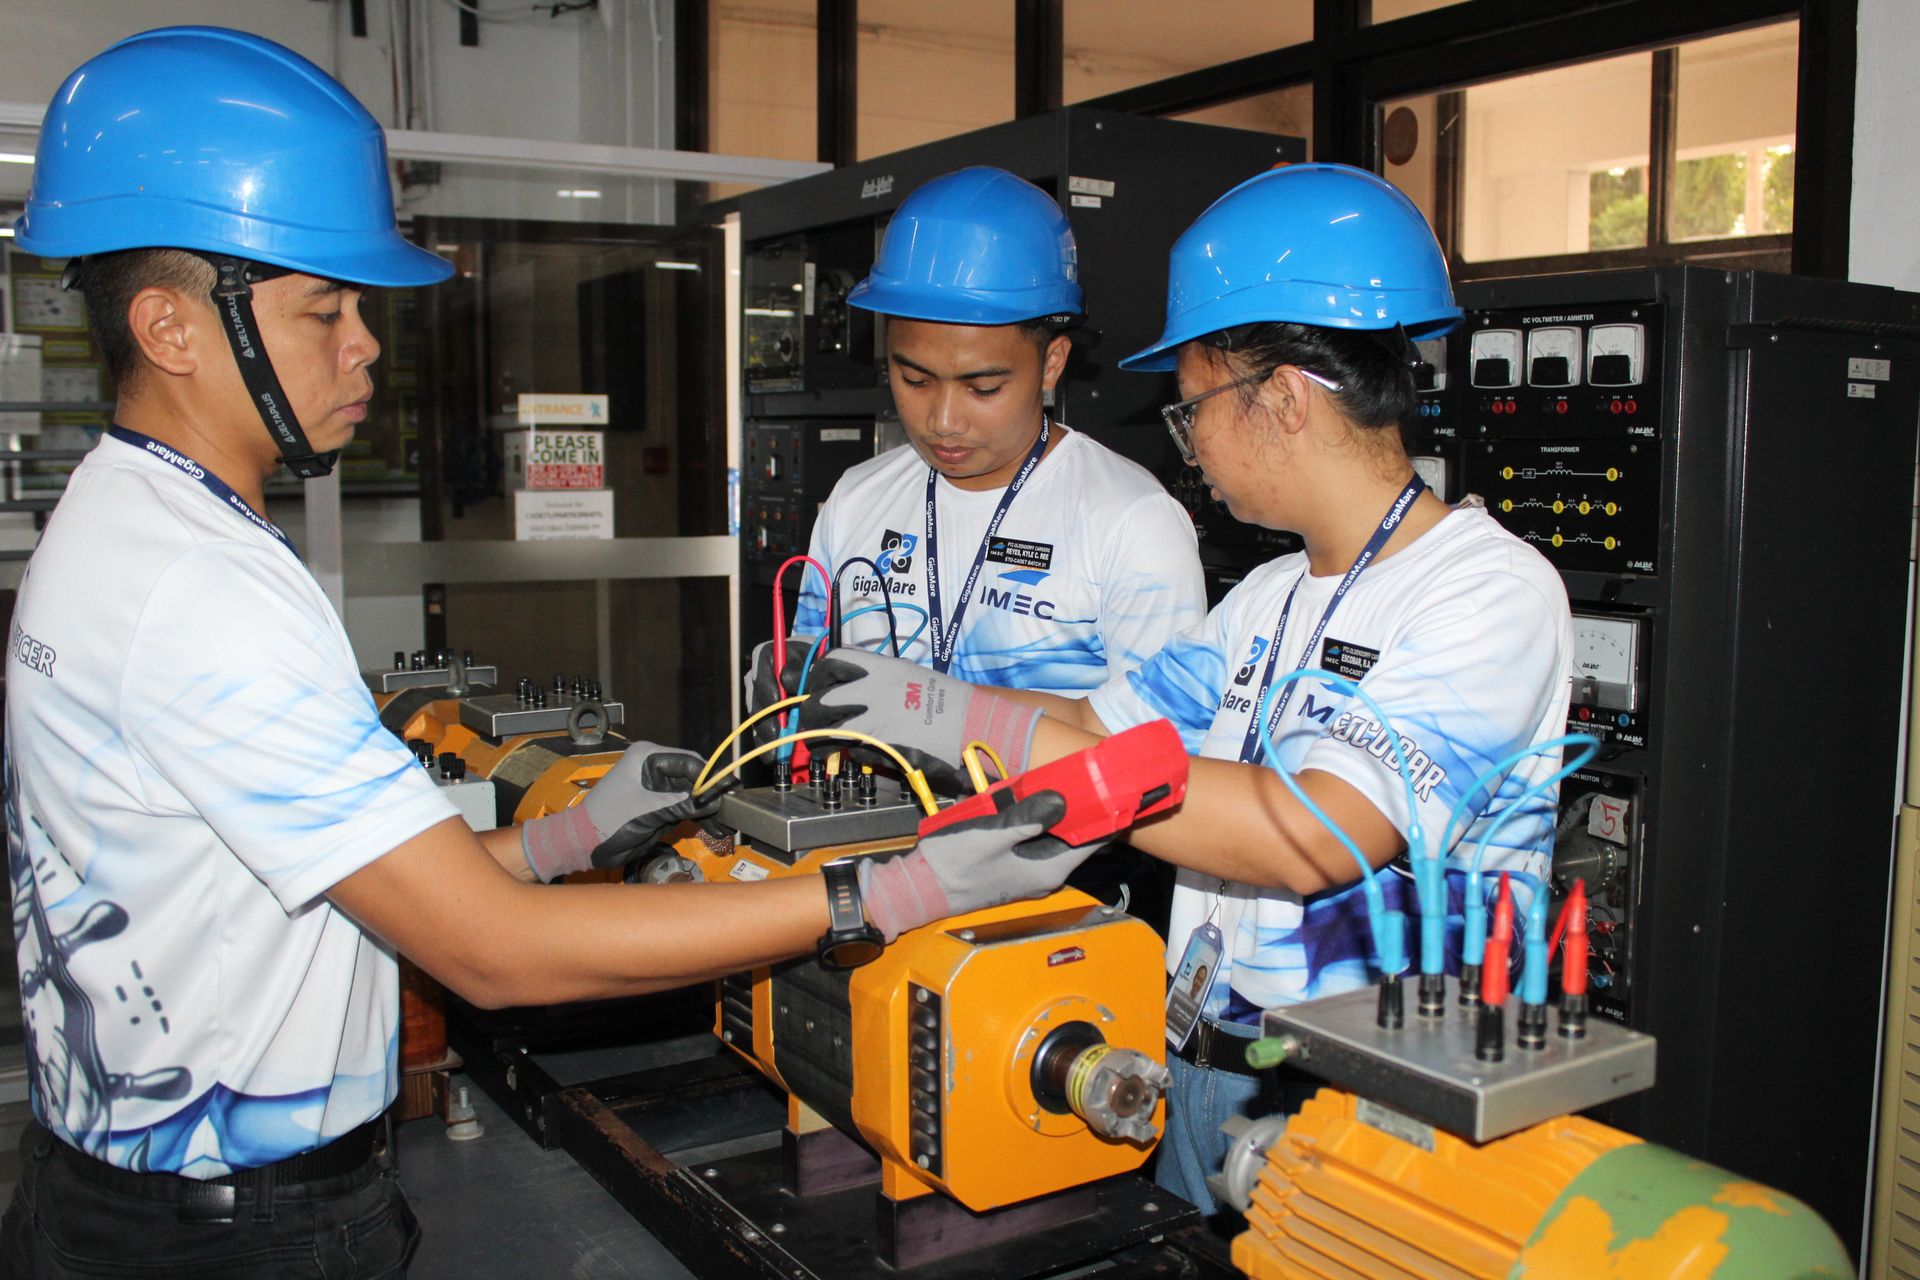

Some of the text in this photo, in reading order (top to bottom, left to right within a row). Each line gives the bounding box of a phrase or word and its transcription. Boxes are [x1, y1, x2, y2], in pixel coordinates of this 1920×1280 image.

[227, 295, 250, 348] DELTAPLU
[262, 392, 290, 436] DELTAPLUS
[146, 441, 205, 480] GigaMare
[530, 450, 599, 463] COME IN
[534, 436, 596, 449] PLEASE
[1012, 456, 1038, 492] GigaMare
[230, 494, 279, 539] GigaMare
[984, 508, 1006, 546] GigaMare
[1382, 488, 1416, 530] GigaMare
[852, 575, 916, 596] GigaMare
[926, 557, 936, 598] GigaMare
[962, 564, 980, 603] GigaMare
[1337, 551, 1372, 596] GigaMare
[979, 586, 1056, 620] IMEC
[931, 617, 940, 658] GigaMare
[941, 622, 958, 662] GigaMare
[1269, 614, 1287, 662] GigaMare
[1300, 619, 1327, 668] GigaMare
[904, 682, 922, 710] 3M
[1249, 686, 1268, 735] GigaMare
[1266, 692, 1289, 737] igaMare
[1580, 774, 1600, 783] MOTOR
[1600, 801, 1620, 836] 5
